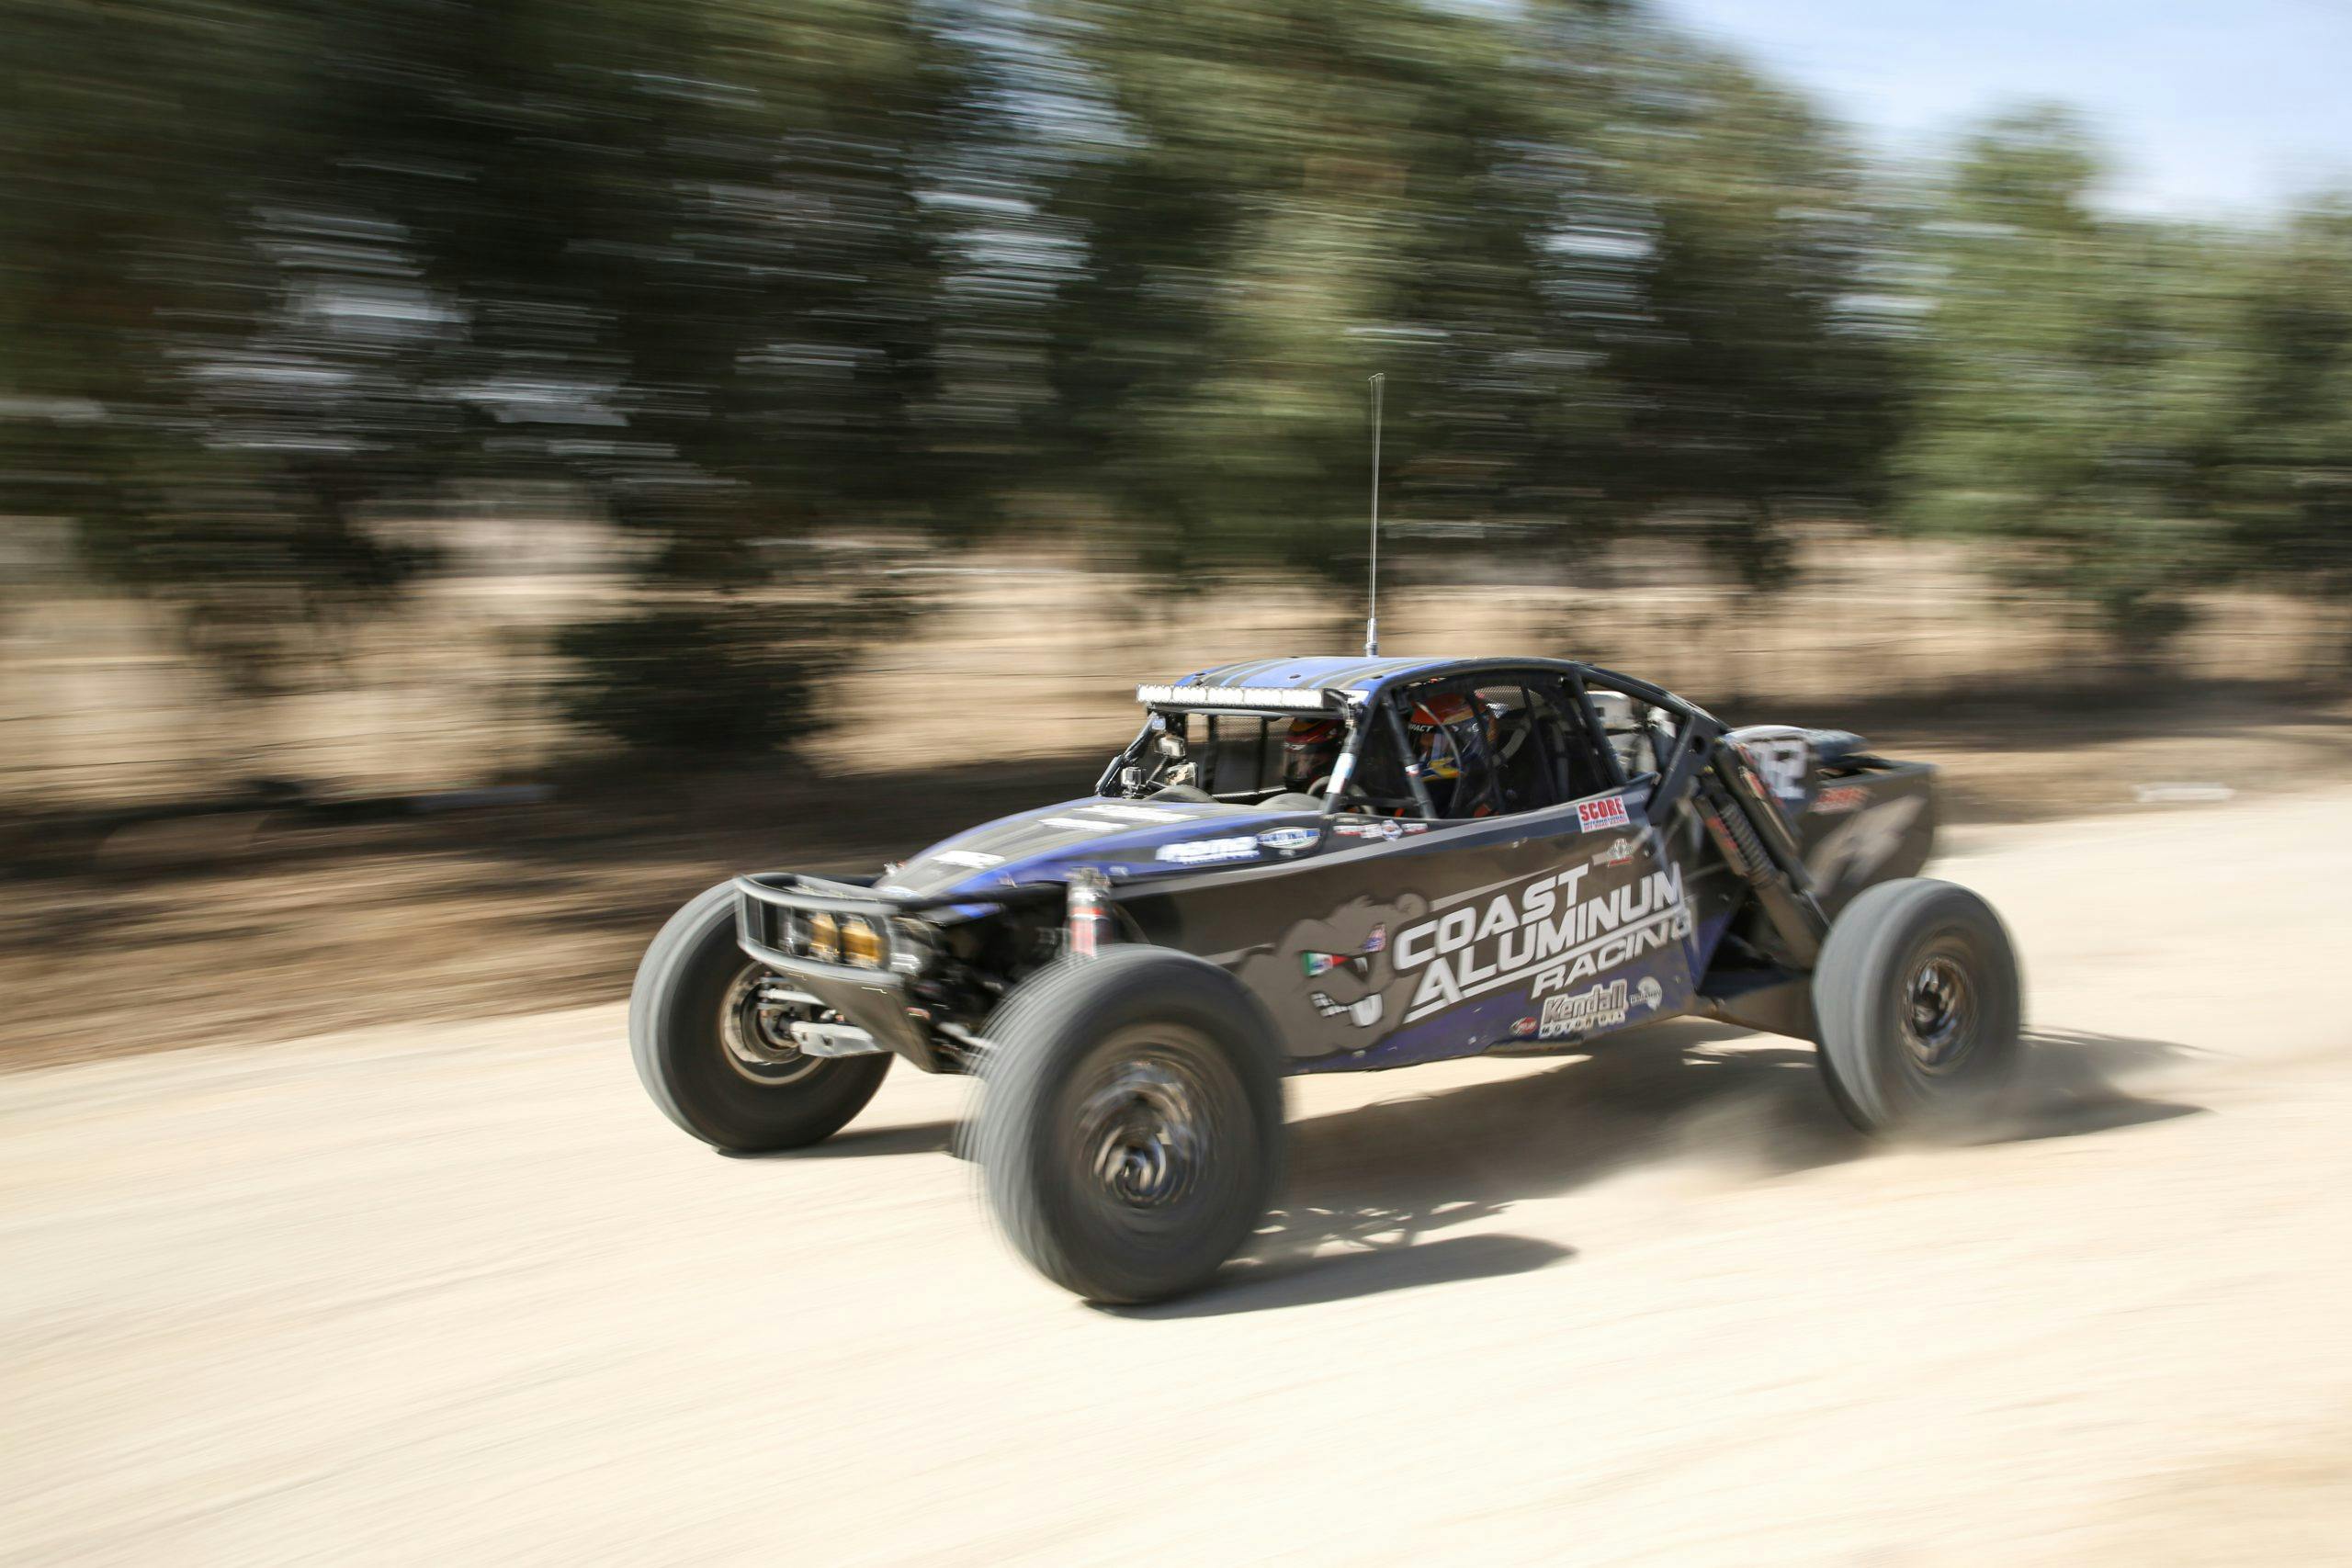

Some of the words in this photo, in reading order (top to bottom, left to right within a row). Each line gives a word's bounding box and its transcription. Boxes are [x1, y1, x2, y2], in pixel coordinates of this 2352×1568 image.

[1579, 797, 1624, 822] SCORE
[1394, 863, 1590, 971] COAST
[1412, 861, 1685, 1009] ALUMINUM
[1543, 982, 1626, 1024] Kendall
